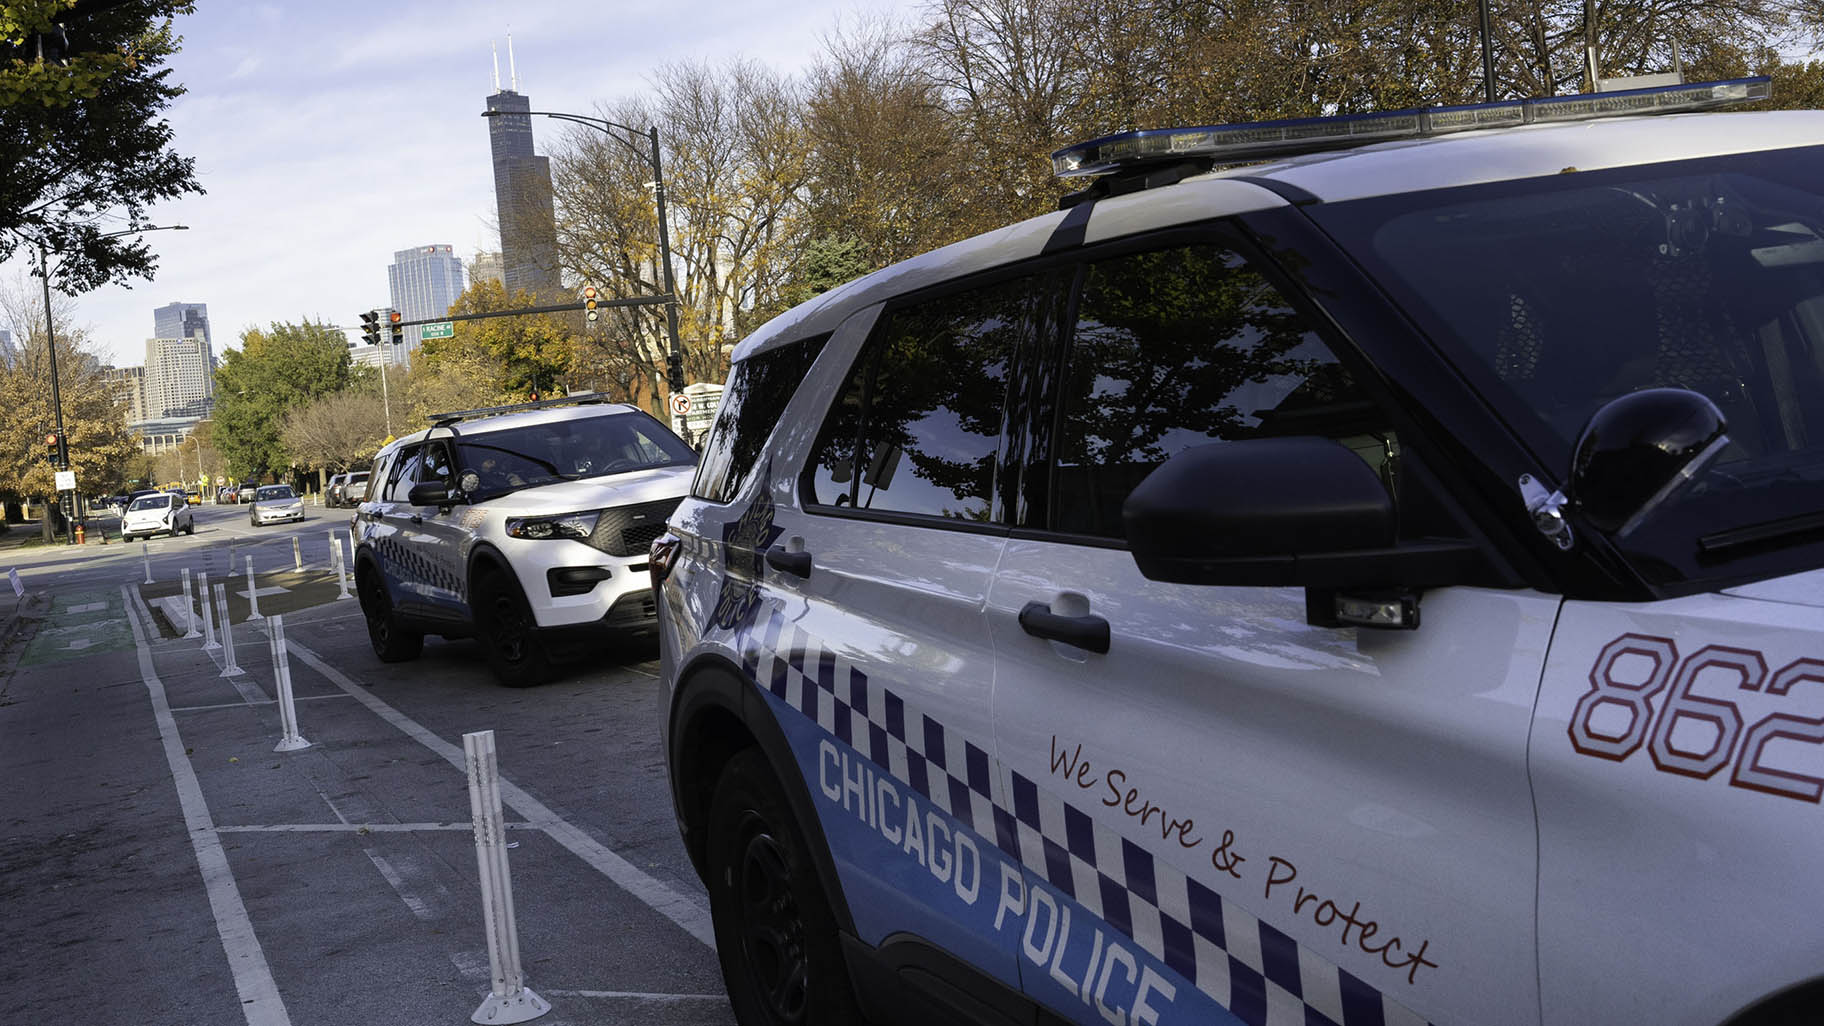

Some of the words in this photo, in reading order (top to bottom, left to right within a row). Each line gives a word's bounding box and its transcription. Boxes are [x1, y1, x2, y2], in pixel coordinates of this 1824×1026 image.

[1567, 632, 1824, 804] 862
[819, 739, 981, 905] CHICAGO
[994, 860, 1177, 1026] POLICE
[1050, 735, 1097, 788] We
[1102, 770, 1202, 848] Serve
[1212, 830, 1245, 879] &
[1265, 857, 1438, 984] Protect
